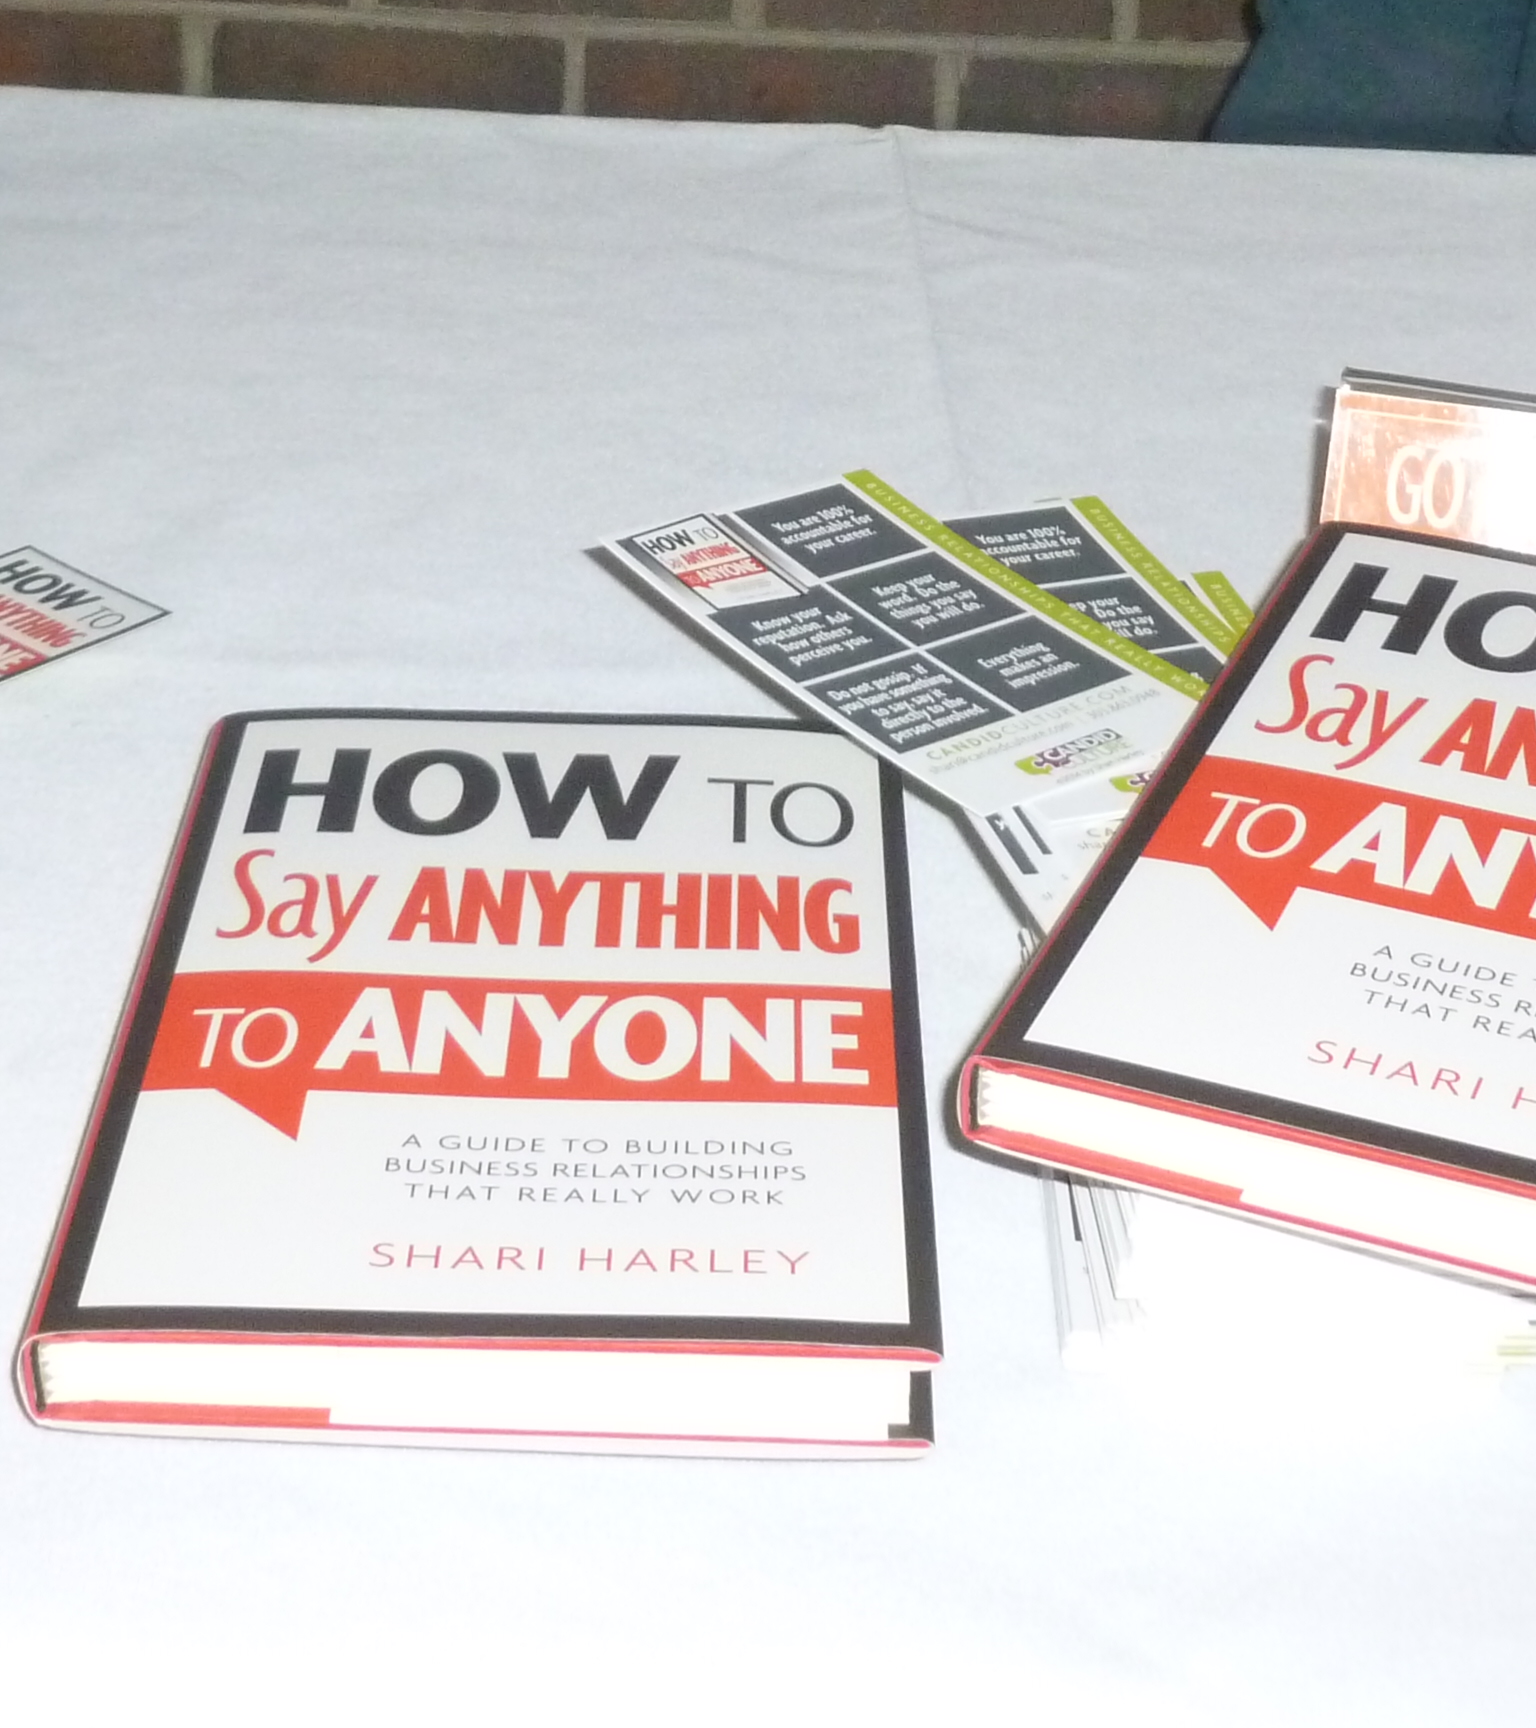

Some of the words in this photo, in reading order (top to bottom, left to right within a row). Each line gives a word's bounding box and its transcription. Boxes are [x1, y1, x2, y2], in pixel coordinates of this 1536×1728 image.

[771, 521, 800, 533] You
[800, 516, 818, 527] are
[816, 504, 854, 521] 100%
[780, 516, 850, 545] accountable
[851, 513, 874, 529] for
[641, 529, 696, 555] HOW
[804, 537, 835, 554] your
[835, 527, 877, 544] career.
[696, 558, 765, 583] ANYONE
[77, 604, 125, 630] TO
[789, 643, 844, 668] perceive
[976, 641, 1052, 669] Everything
[1254, 652, 1431, 774] Say
[242, 748, 681, 843] HOW
[705, 775, 857, 850] TO
[1202, 789, 1310, 860] TO
[214, 847, 381, 964] Say
[387, 865, 862, 955] ANYTHING
[1372, 942, 1396, 963] A
[1409, 946, 1519, 989] GUIDE
[1349, 960, 1506, 1017] BUSINESS
[1362, 988, 1459, 1025] THAT
[191, 1005, 301, 1070] TO
[312, 985, 872, 1087] ANYONE
[1306, 1036, 1484, 1101] SHARI
[399, 1132, 423, 1150] A
[438, 1134, 547, 1154] GUIDE
[561, 1137, 609, 1156] TO
[624, 1138, 796, 1158] BUILDING
[383, 1157, 540, 1179] BUSINESS
[552, 1161, 810, 1183] RELATIONSHIPS
[402, 1183, 496, 1204] THAT
[516, 1185, 652, 1206] REALLY
[669, 1186, 787, 1207] WORK
[367, 1241, 546, 1273] SHARI
[577, 1244, 813, 1278] HARLEY
